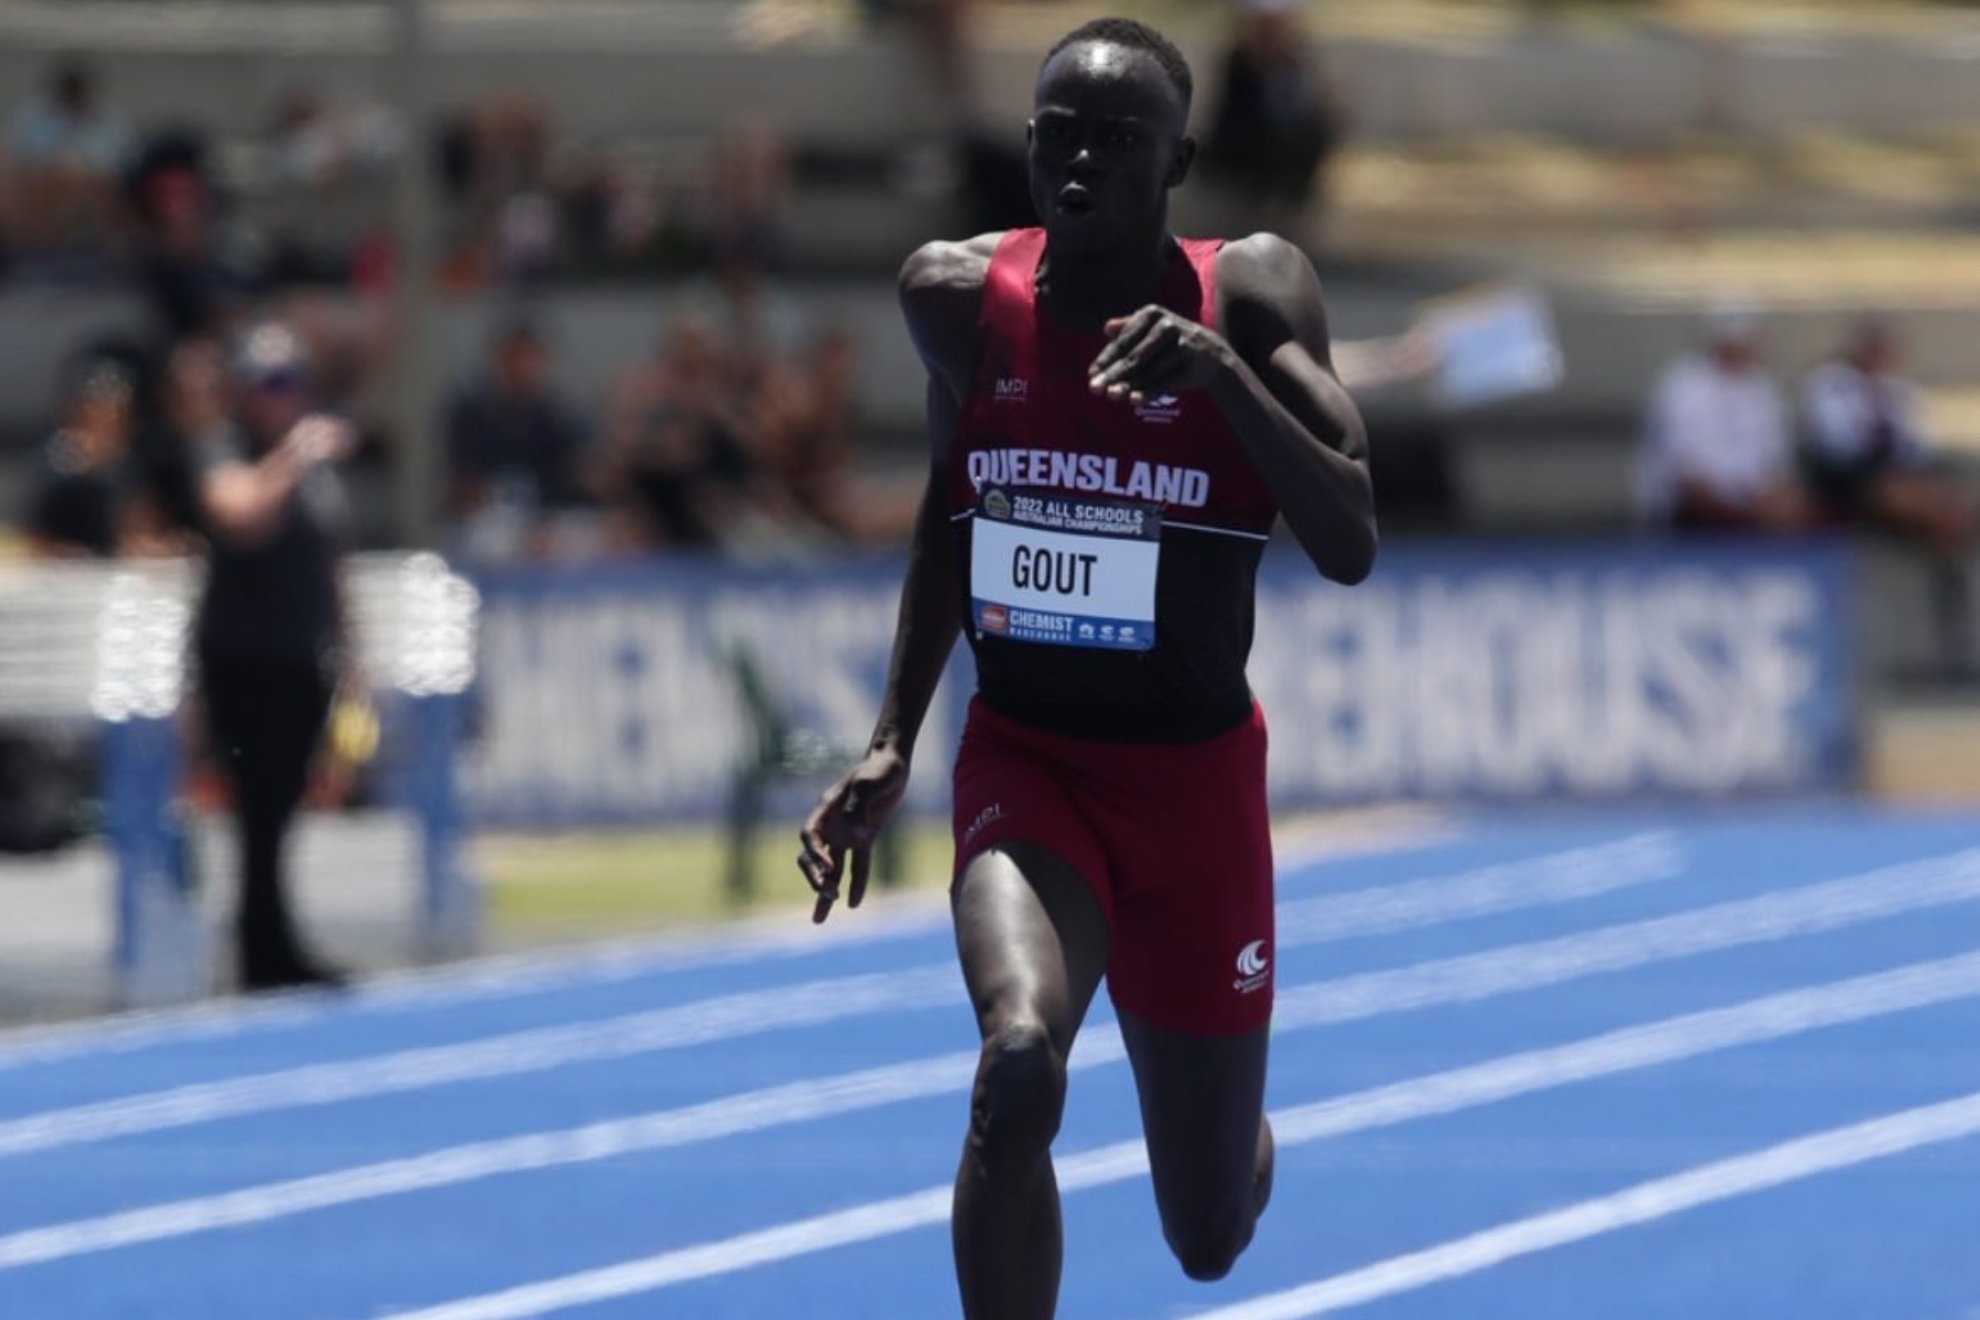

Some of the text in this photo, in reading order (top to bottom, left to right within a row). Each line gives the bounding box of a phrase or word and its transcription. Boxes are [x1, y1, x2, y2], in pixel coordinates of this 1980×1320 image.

[967, 448, 1210, 508] QUEENSLAND
[1013, 496, 1043, 515] 2022
[1045, 501, 1070, 518] ALL
[1075, 504, 1144, 524] SCHOOLS
[1012, 544, 1098, 597] GOUT
[1009, 609, 1073, 633] CHEMIST
